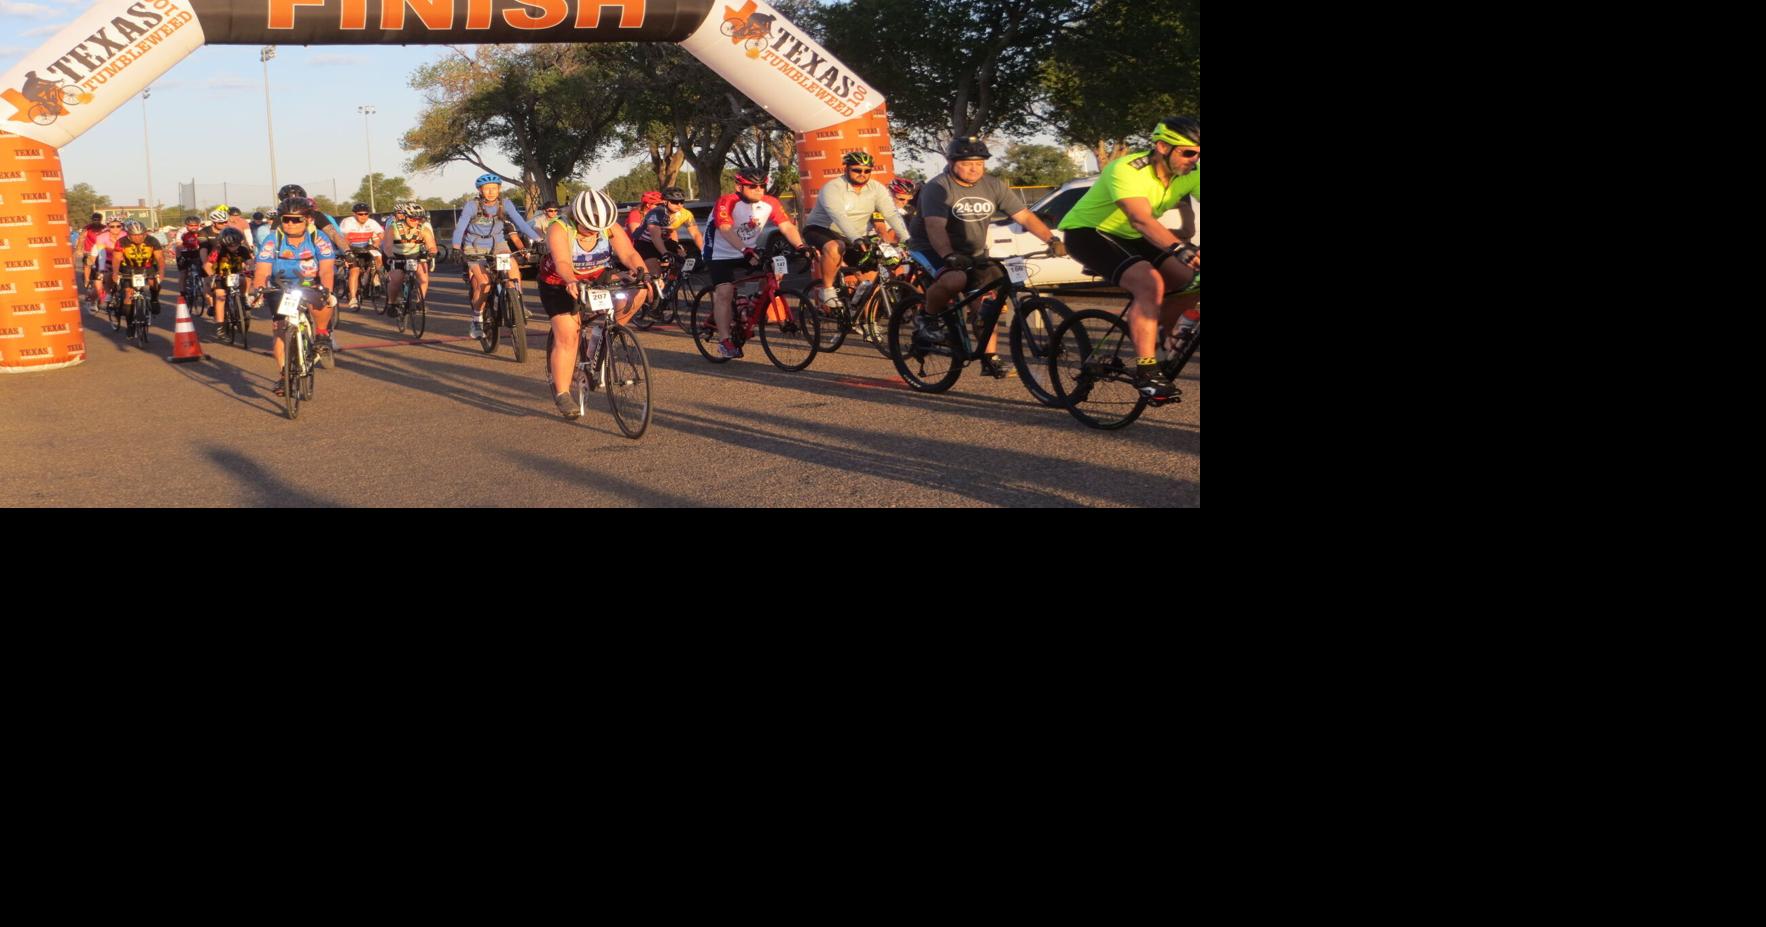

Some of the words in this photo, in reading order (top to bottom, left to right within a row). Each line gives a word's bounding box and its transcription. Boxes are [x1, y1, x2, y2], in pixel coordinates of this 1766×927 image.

[145, 0, 179, 16] 10
[47, 2, 163, 83] TEXAS
[82, 11, 192, 92] TUMBLEWEED
[770, 27, 855, 98] TEXAS
[761, 50, 854, 117] TUMBLEWEED
[847, 85, 867, 107] 100
[0, 171, 21, 179] EXAS
[21, 192, 47, 200] TEXAS
[956, 202, 990, 213] 24:00
[5, 260, 34, 268] TEXAS
[33, 280, 59, 288] TEXAS
[11, 304, 40, 312] TEXAS
[42, 324, 66, 332] TEXAS
[20, 348, 48, 356] TEXAS
